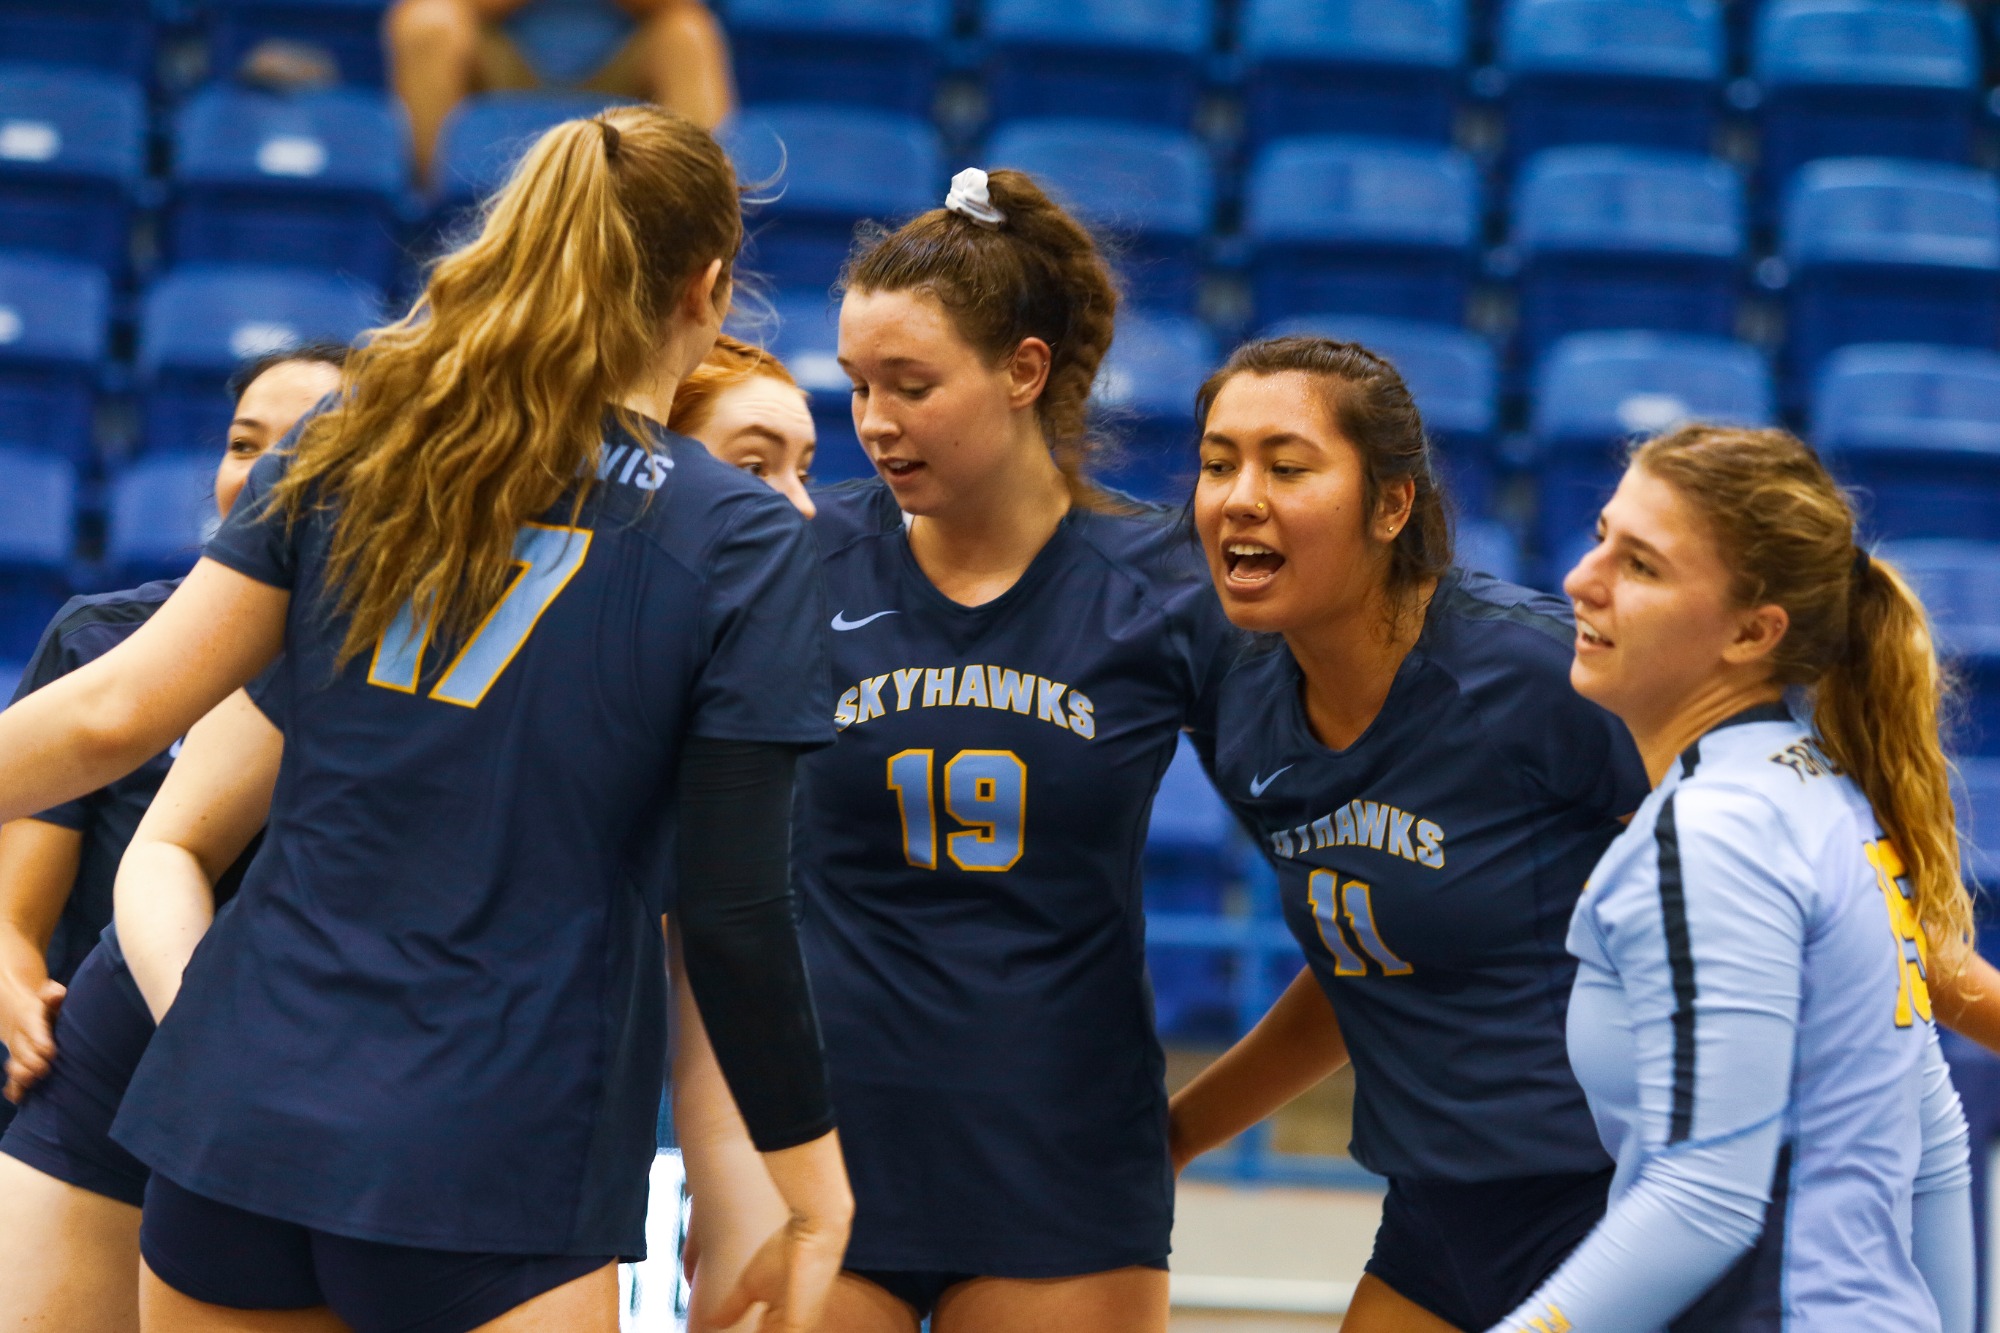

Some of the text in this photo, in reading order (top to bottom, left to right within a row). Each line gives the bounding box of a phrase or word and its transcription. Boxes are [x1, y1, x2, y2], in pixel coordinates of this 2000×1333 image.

[833, 664, 1096, 740] SKYHAWKS
[886, 748, 1028, 872] 19
[1307, 867, 1415, 977] 11
